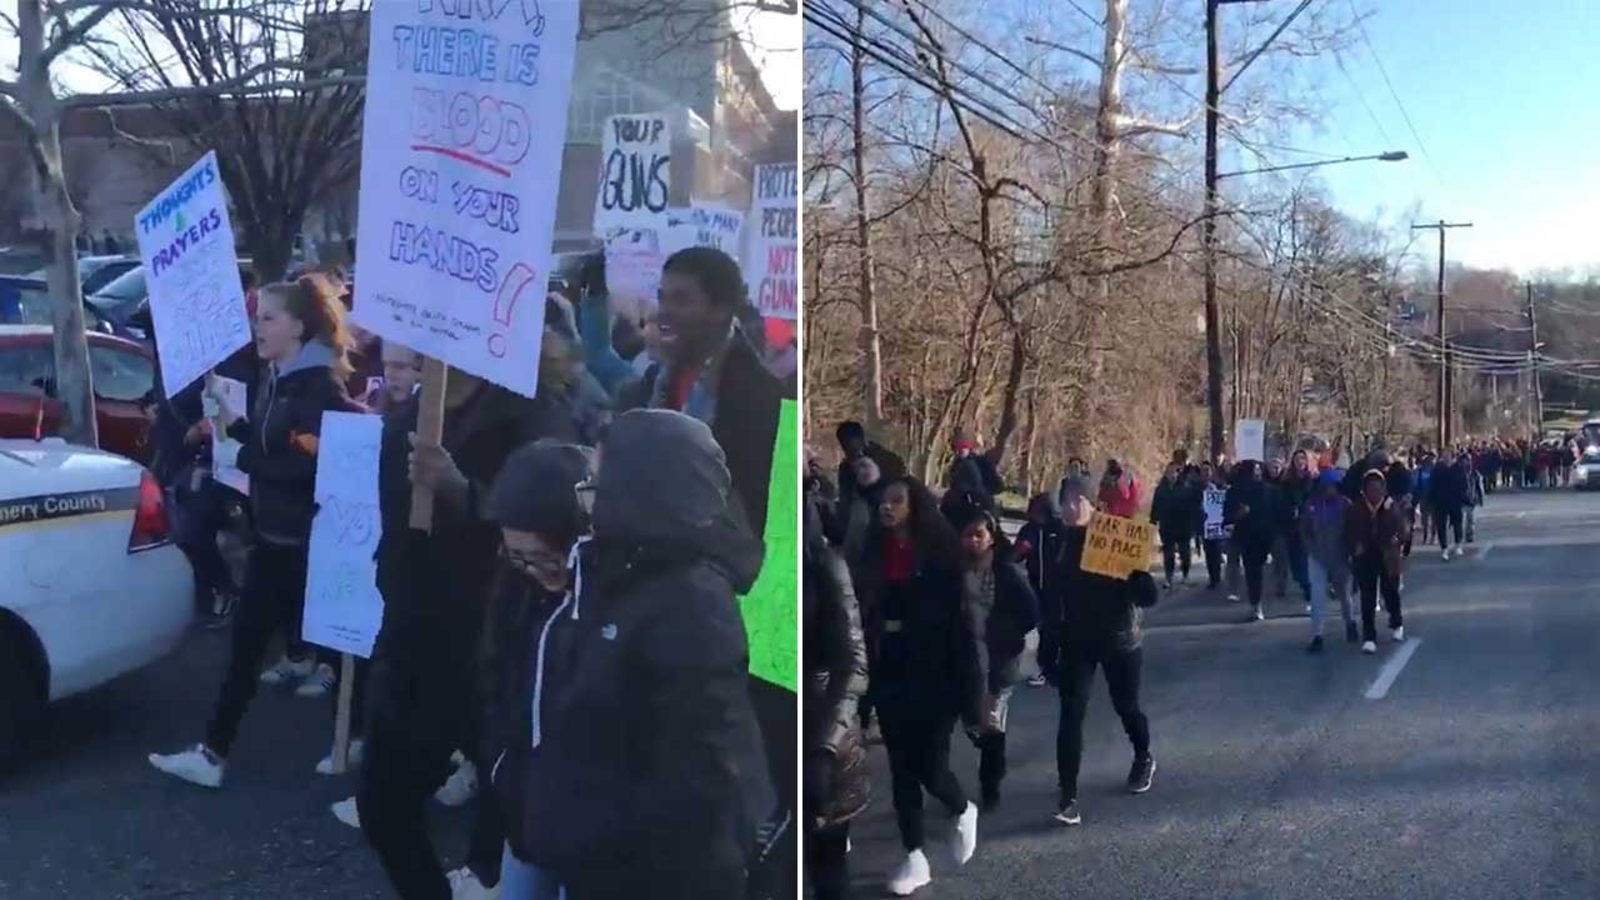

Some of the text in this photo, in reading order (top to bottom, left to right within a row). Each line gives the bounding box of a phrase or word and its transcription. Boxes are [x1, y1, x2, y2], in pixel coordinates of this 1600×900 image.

[393, 25, 541, 86] THERE IS
[411, 87, 532, 165] BLOOD
[613, 117, 664, 145] YOUR
[139, 162, 216, 235] THOUGHTS
[400, 166, 519, 233] ON YOUR
[603, 149, 670, 213] GUNS
[151, 207, 221, 278] PRAYERS
[44, 494, 106, 513] County
